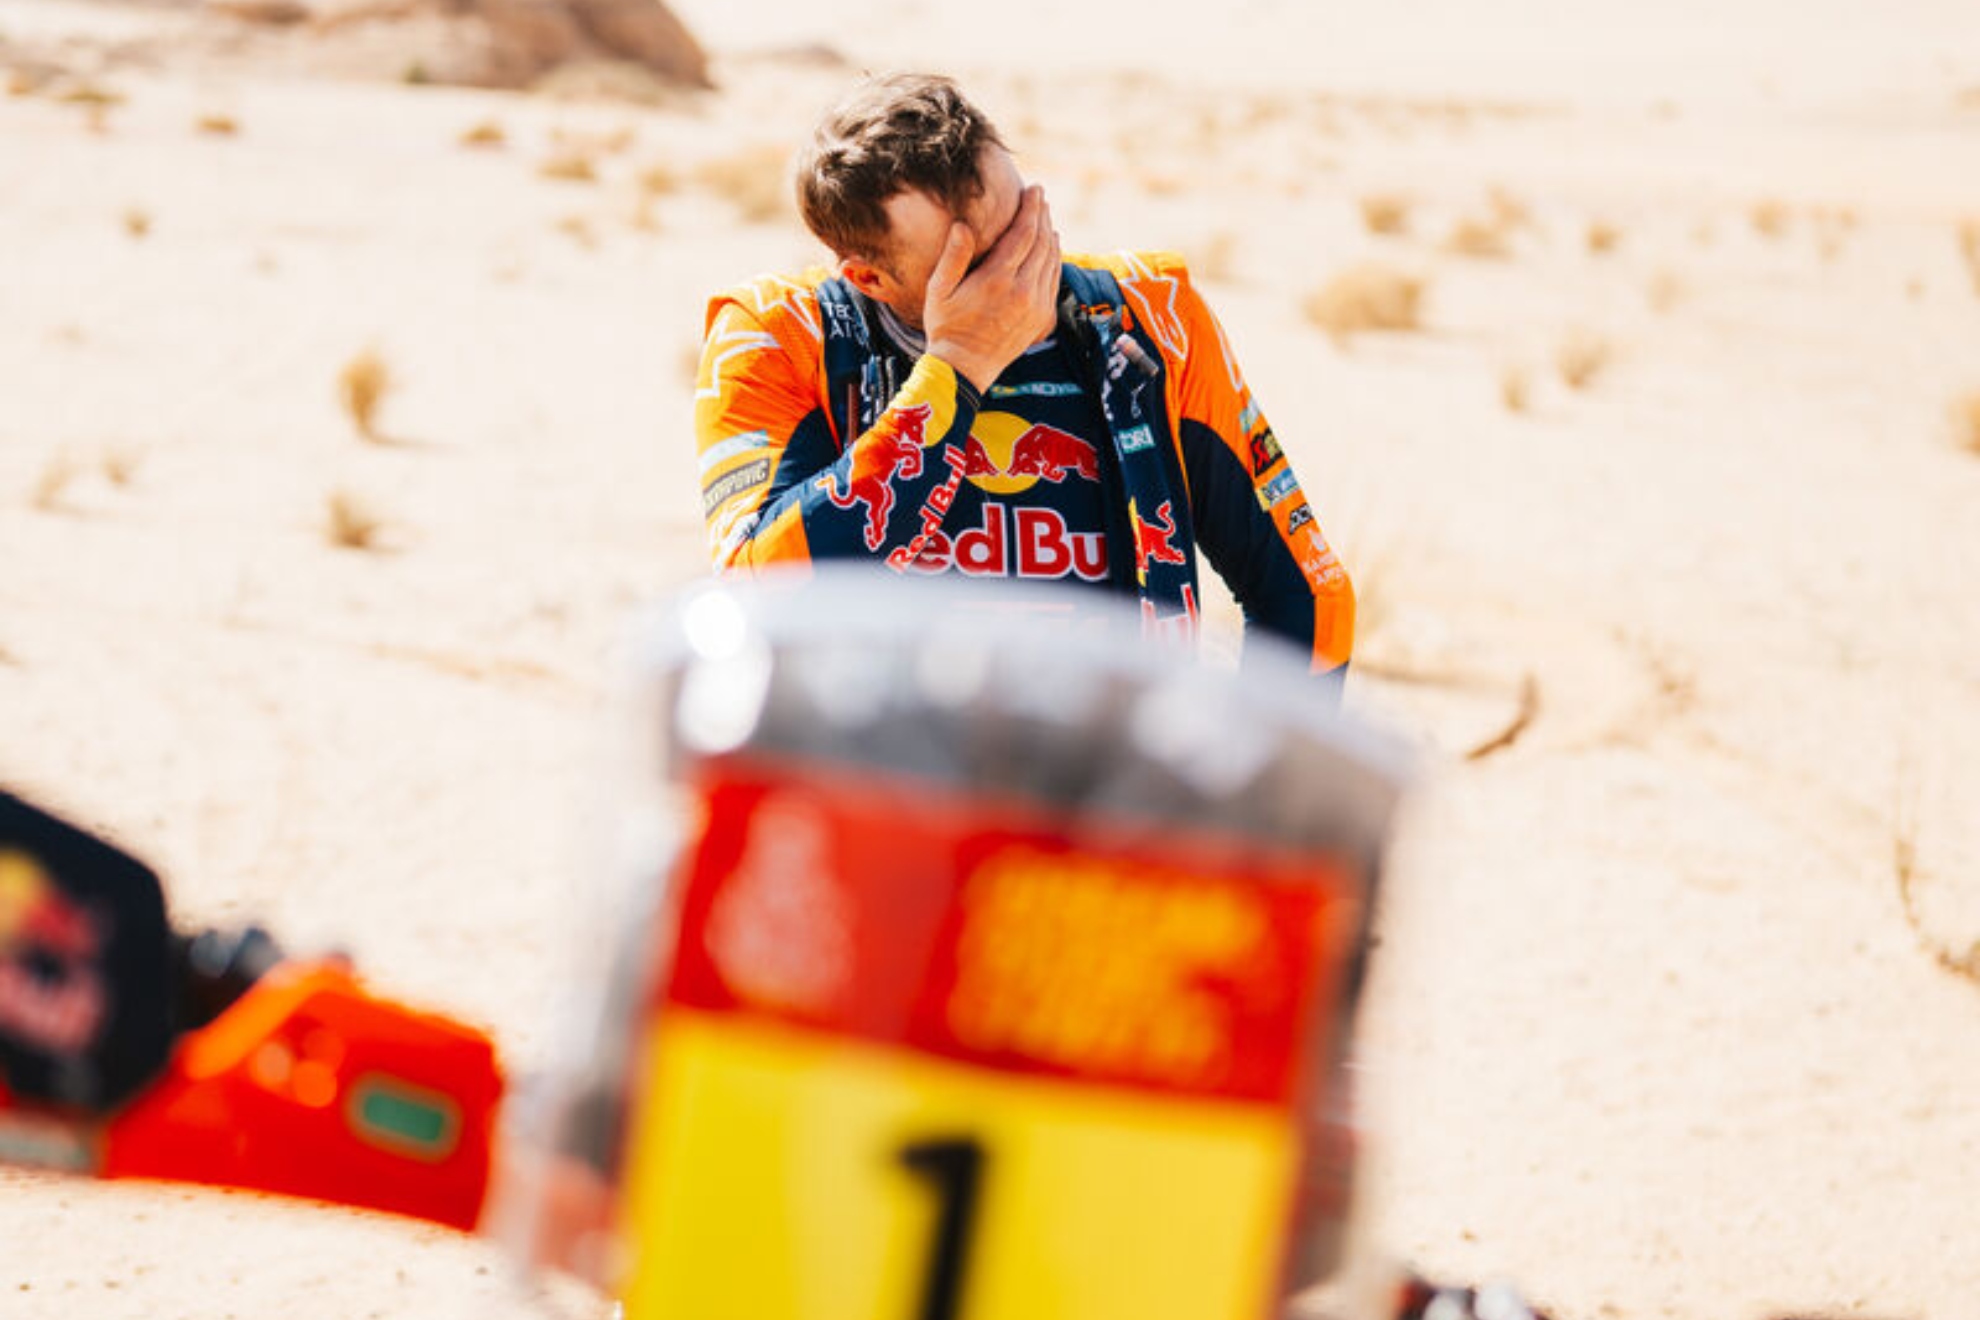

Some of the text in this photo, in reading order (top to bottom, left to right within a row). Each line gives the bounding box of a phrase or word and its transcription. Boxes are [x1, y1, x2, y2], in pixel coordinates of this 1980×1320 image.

[909, 503, 1110, 581] ed Bu
[893, 1134, 992, 1320] 1
